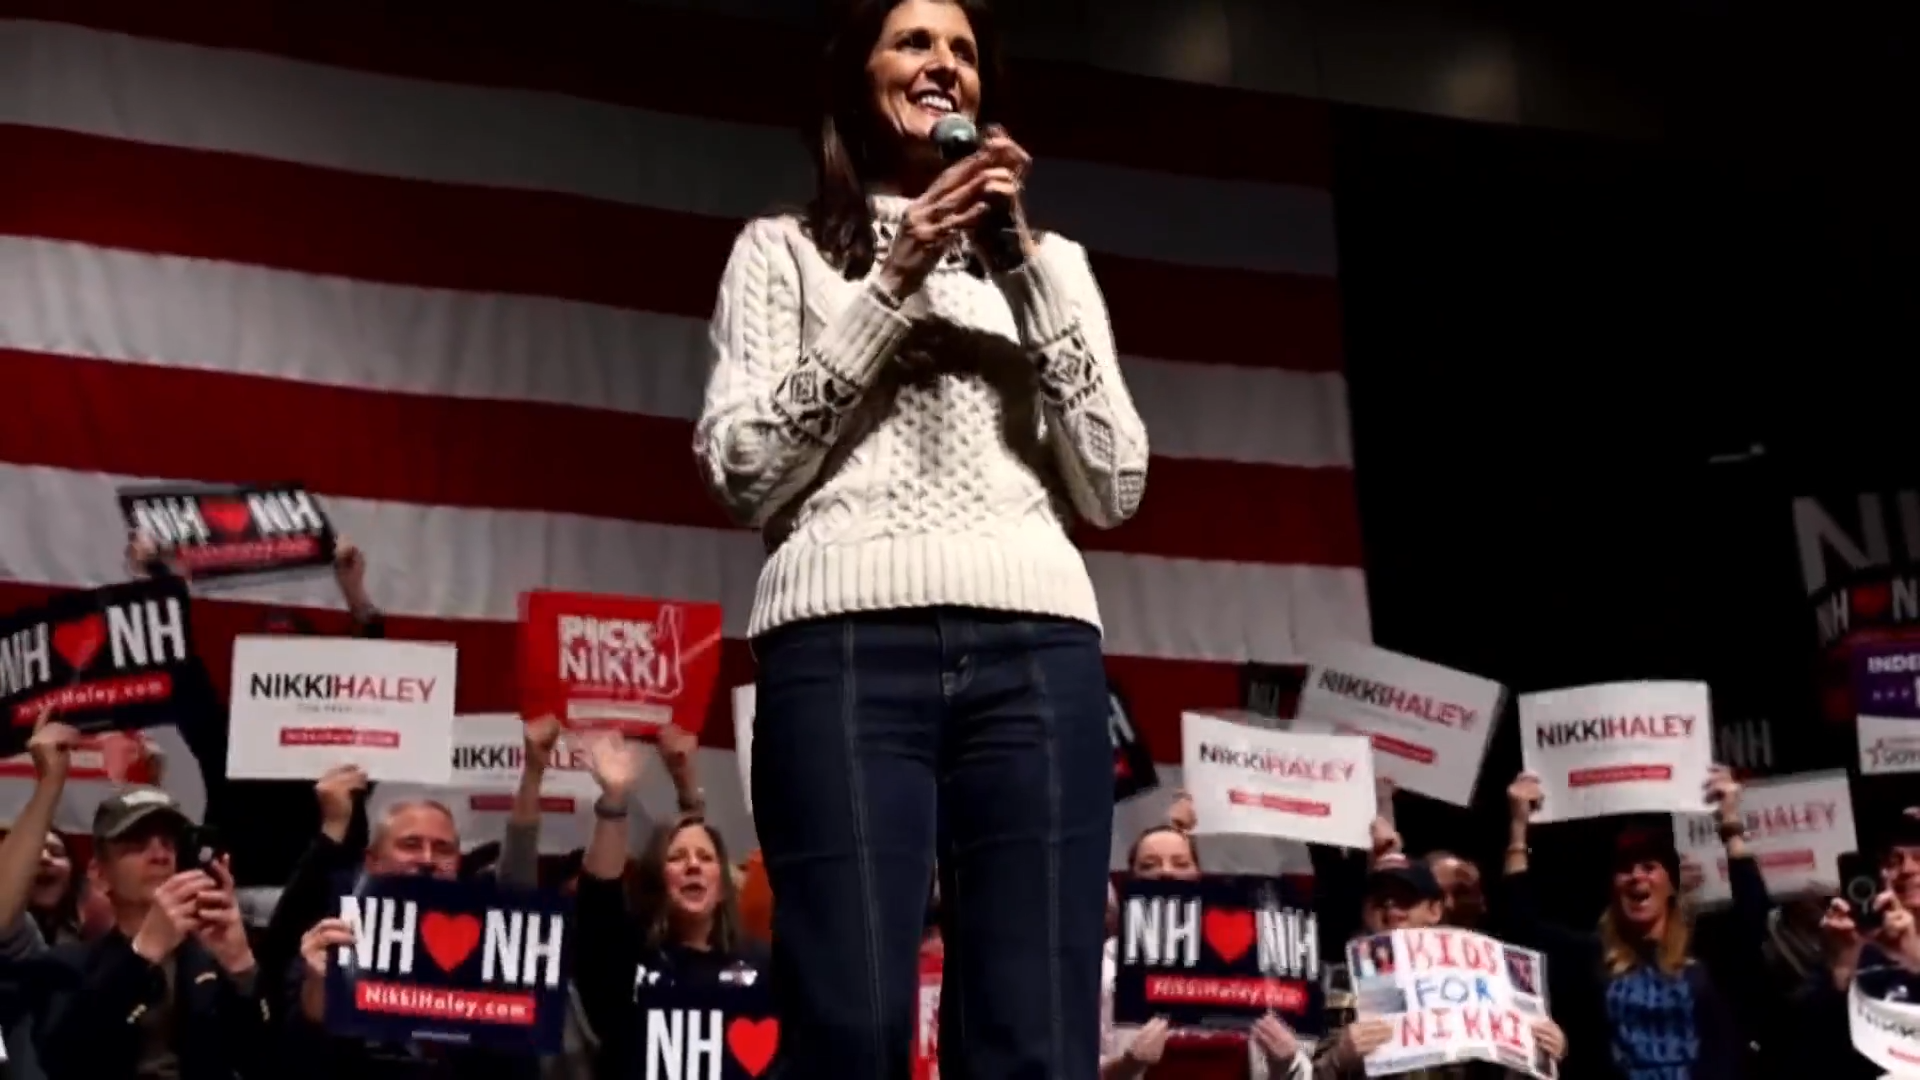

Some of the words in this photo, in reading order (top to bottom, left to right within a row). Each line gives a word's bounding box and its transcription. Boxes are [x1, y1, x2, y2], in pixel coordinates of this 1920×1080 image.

[246, 489, 324, 536] NH
[106, 597, 187, 669] NH
[557, 614, 655, 651] PICK
[250, 672, 436, 704] NIKKIHALEY
[558, 646, 668, 688] NIKKI
[1536, 715, 1695, 749] NIKKIHALEY
[453, 747, 590, 771] IKKILE
[337, 895, 419, 975] NH
[481, 908, 564, 990] NH
[1124, 894, 1203, 968] NH
[1255, 906, 1320, 981] NH
[1406, 932, 1498, 976] KIDS
[366, 985, 529, 1018] NikkiHaley.com
[1415, 976, 1495, 1008] FOR
[646, 1008, 724, 1080] NH
[1401, 1006, 1524, 1048] NIKKI
